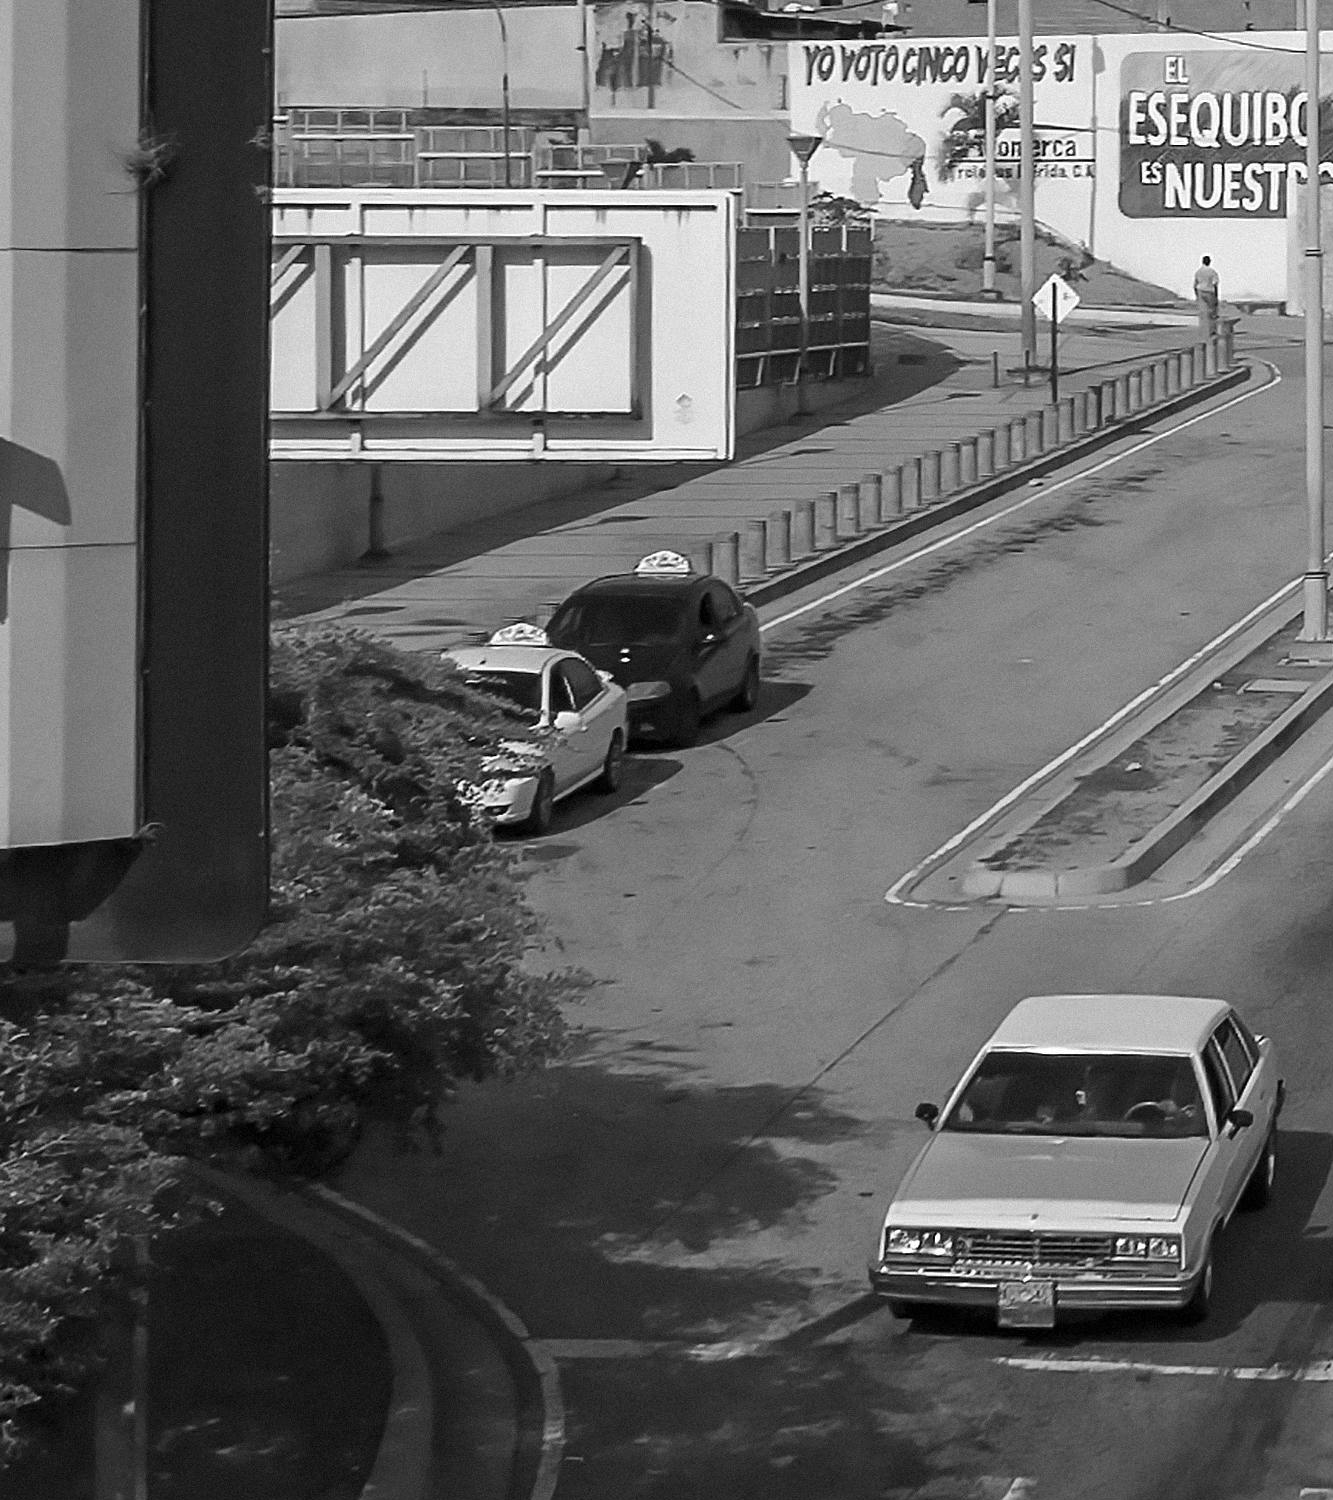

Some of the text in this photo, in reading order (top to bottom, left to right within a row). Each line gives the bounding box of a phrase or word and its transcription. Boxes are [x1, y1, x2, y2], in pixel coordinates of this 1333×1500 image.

[803, 45, 835, 86] YO
[840, 44, 899, 86] VOTO
[903, 46, 969, 86] CINCO
[1053, 43, 1076, 82] SI
[1164, 55, 1190, 84] EL
[1140, 160, 1163, 184] ES
